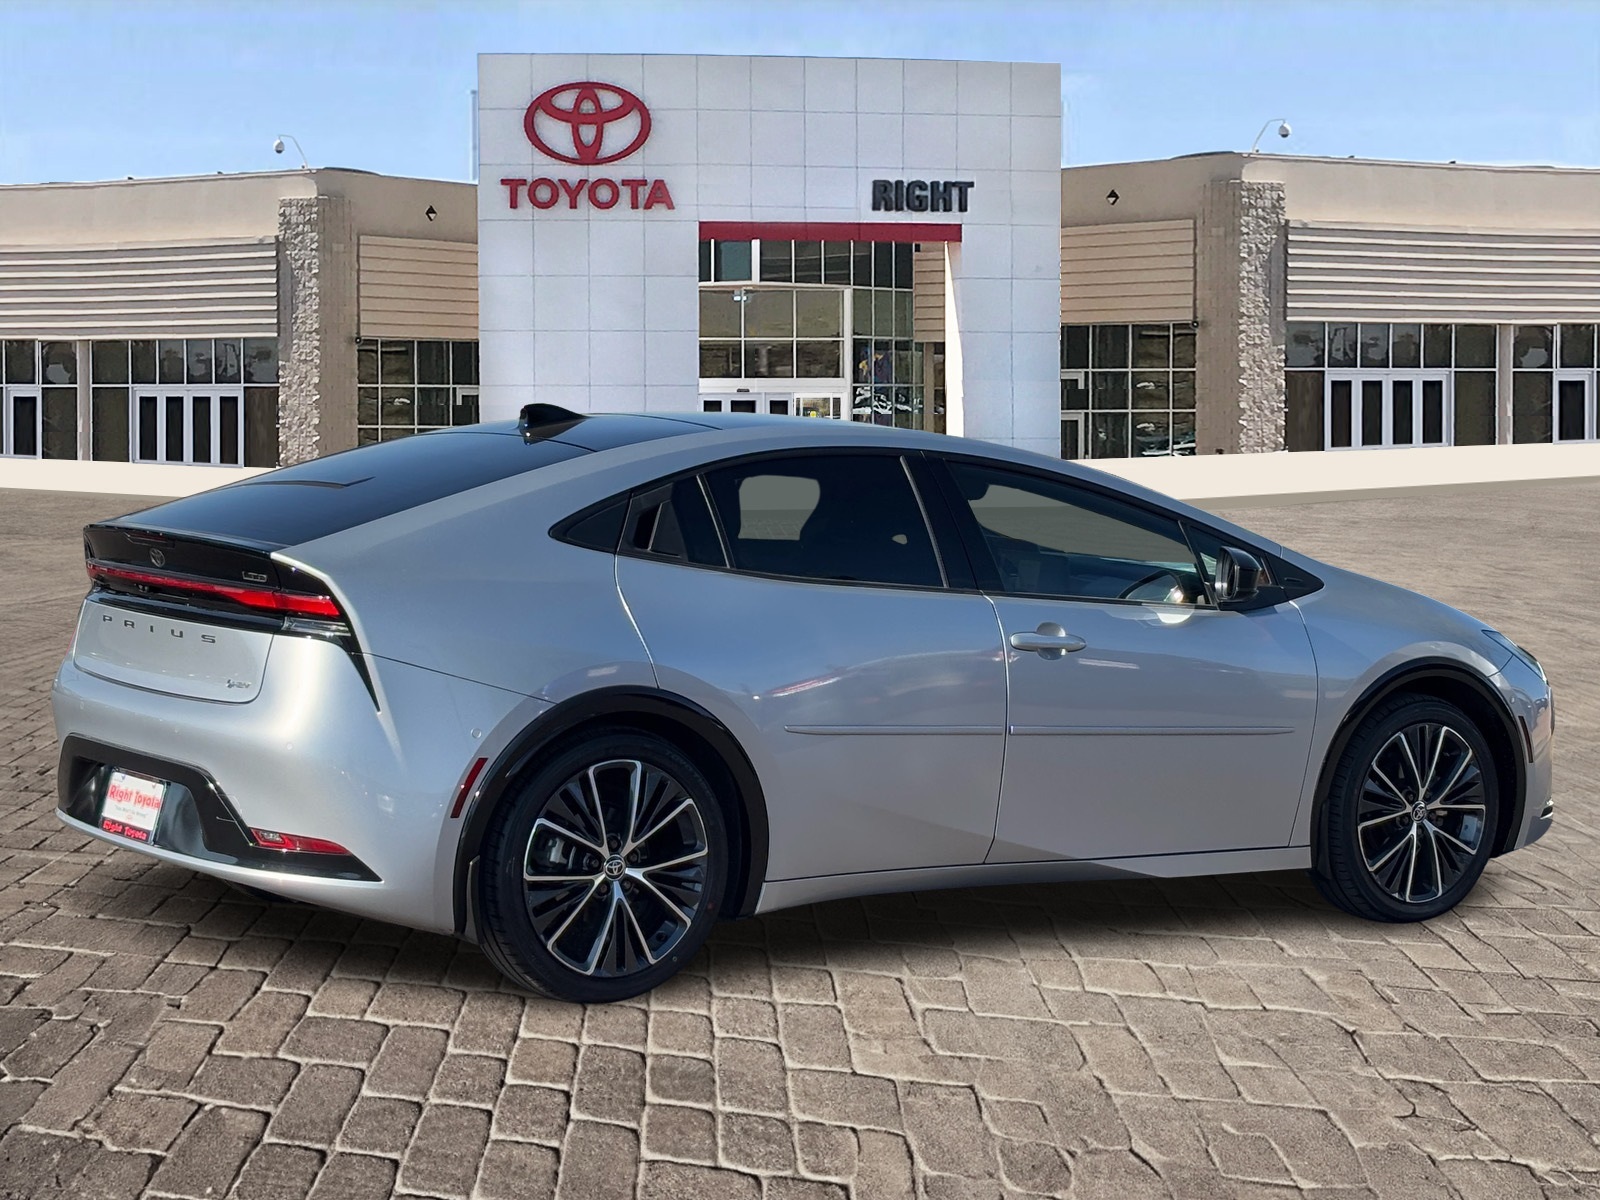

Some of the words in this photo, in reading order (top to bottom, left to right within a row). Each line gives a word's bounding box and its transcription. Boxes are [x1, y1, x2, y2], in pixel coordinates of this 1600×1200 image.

[500, 178, 675, 210] TOYOTA
[872, 180, 974, 212] RIGHT
[102, 614, 216, 643] PRIUS
[109, 784, 133, 803] Right
[134, 791, 161, 809] Toyota
[103, 820, 122, 832] Right
[124, 826, 147, 840] Toyota
